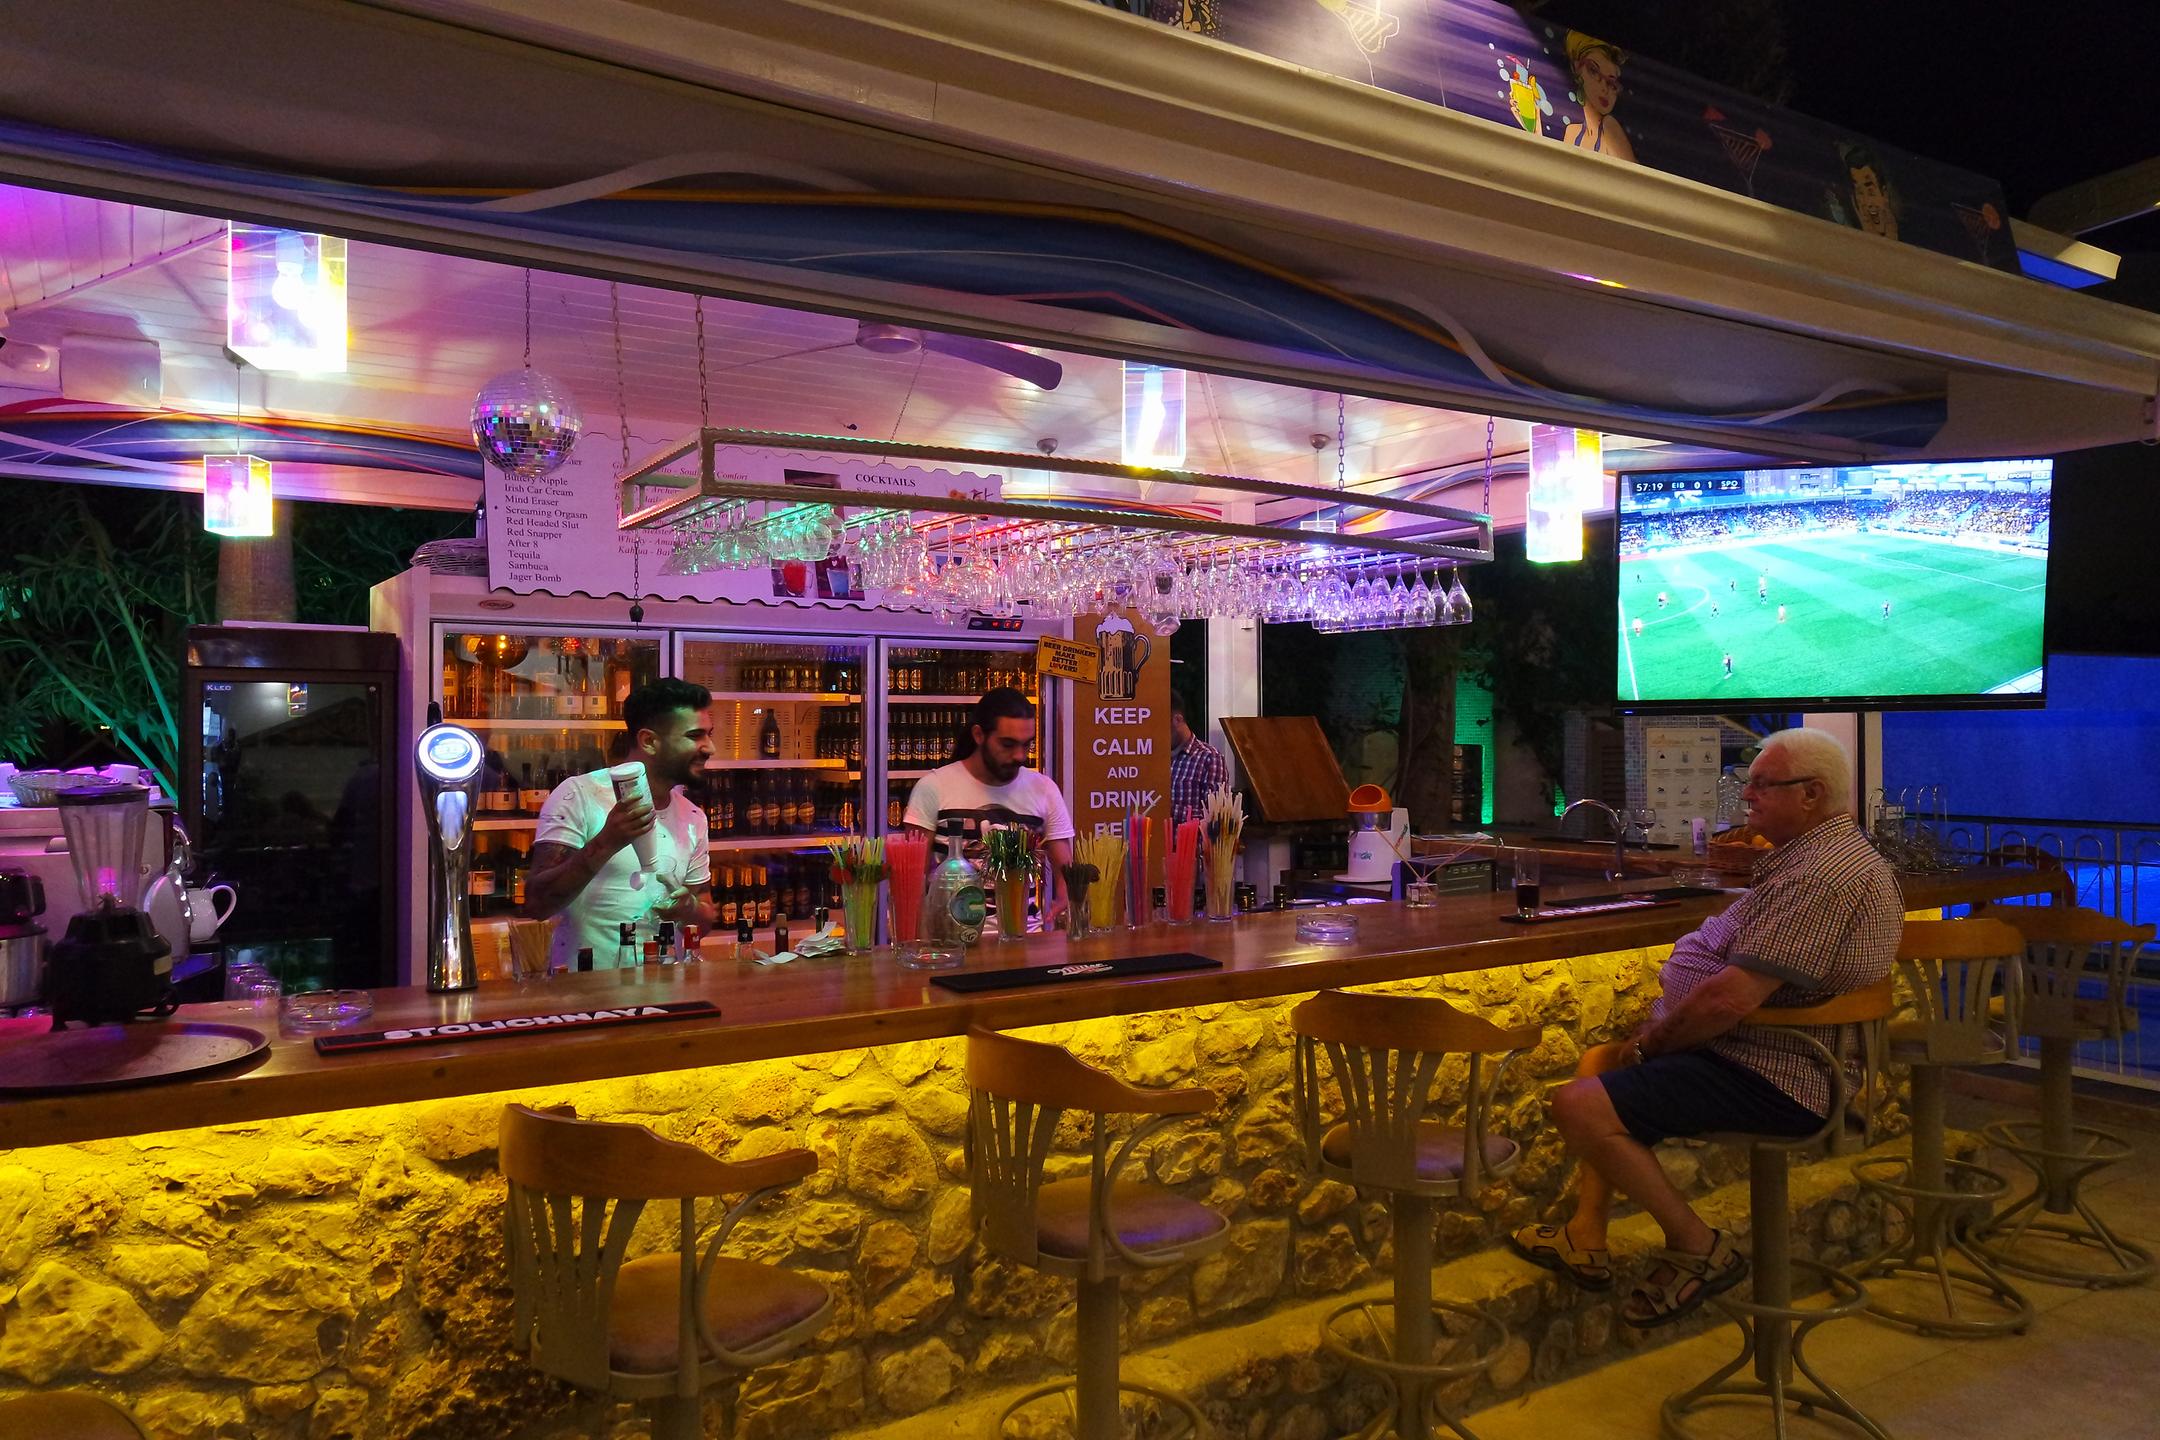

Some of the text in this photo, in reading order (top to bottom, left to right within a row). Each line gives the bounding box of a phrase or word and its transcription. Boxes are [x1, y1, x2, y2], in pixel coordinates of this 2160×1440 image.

[540, 475, 568, 486] Nipple
[716, 471, 748, 480] Comfort
[855, 473, 916, 487] COCKTAILS
[504, 484, 574, 497] Irish Car Cream
[1636, 482, 1664, 492] 57:19
[1693, 481, 1701, 489] 0
[1707, 481, 1712, 489] 1
[505, 494, 559, 506] Mind Eraser
[505, 505, 588, 520] Screaming Orgasm
[506, 516, 579, 529] Red Headed Slut
[507, 528, 562, 540] Red Snapper
[507, 539, 539, 548] After 8
[508, 549, 541, 560] Tequila
[618, 546, 648, 555] Kahua
[508, 561, 549, 571] Sambuca
[509, 572, 562, 582] Jager Bomb
[1044, 642, 1096, 657] BEER DRINKERS
[1055, 650, 1076, 659] MAKE
[1052, 656, 1078, 666] BETTER
[1094, 707, 1151, 724] KEEP
[1092, 738, 1153, 756] CALM
[1107, 766, 1139, 779] AND
[1090, 790, 1156, 809] DRINK
[383, 1006, 669, 1040] STOLICHNAYA
